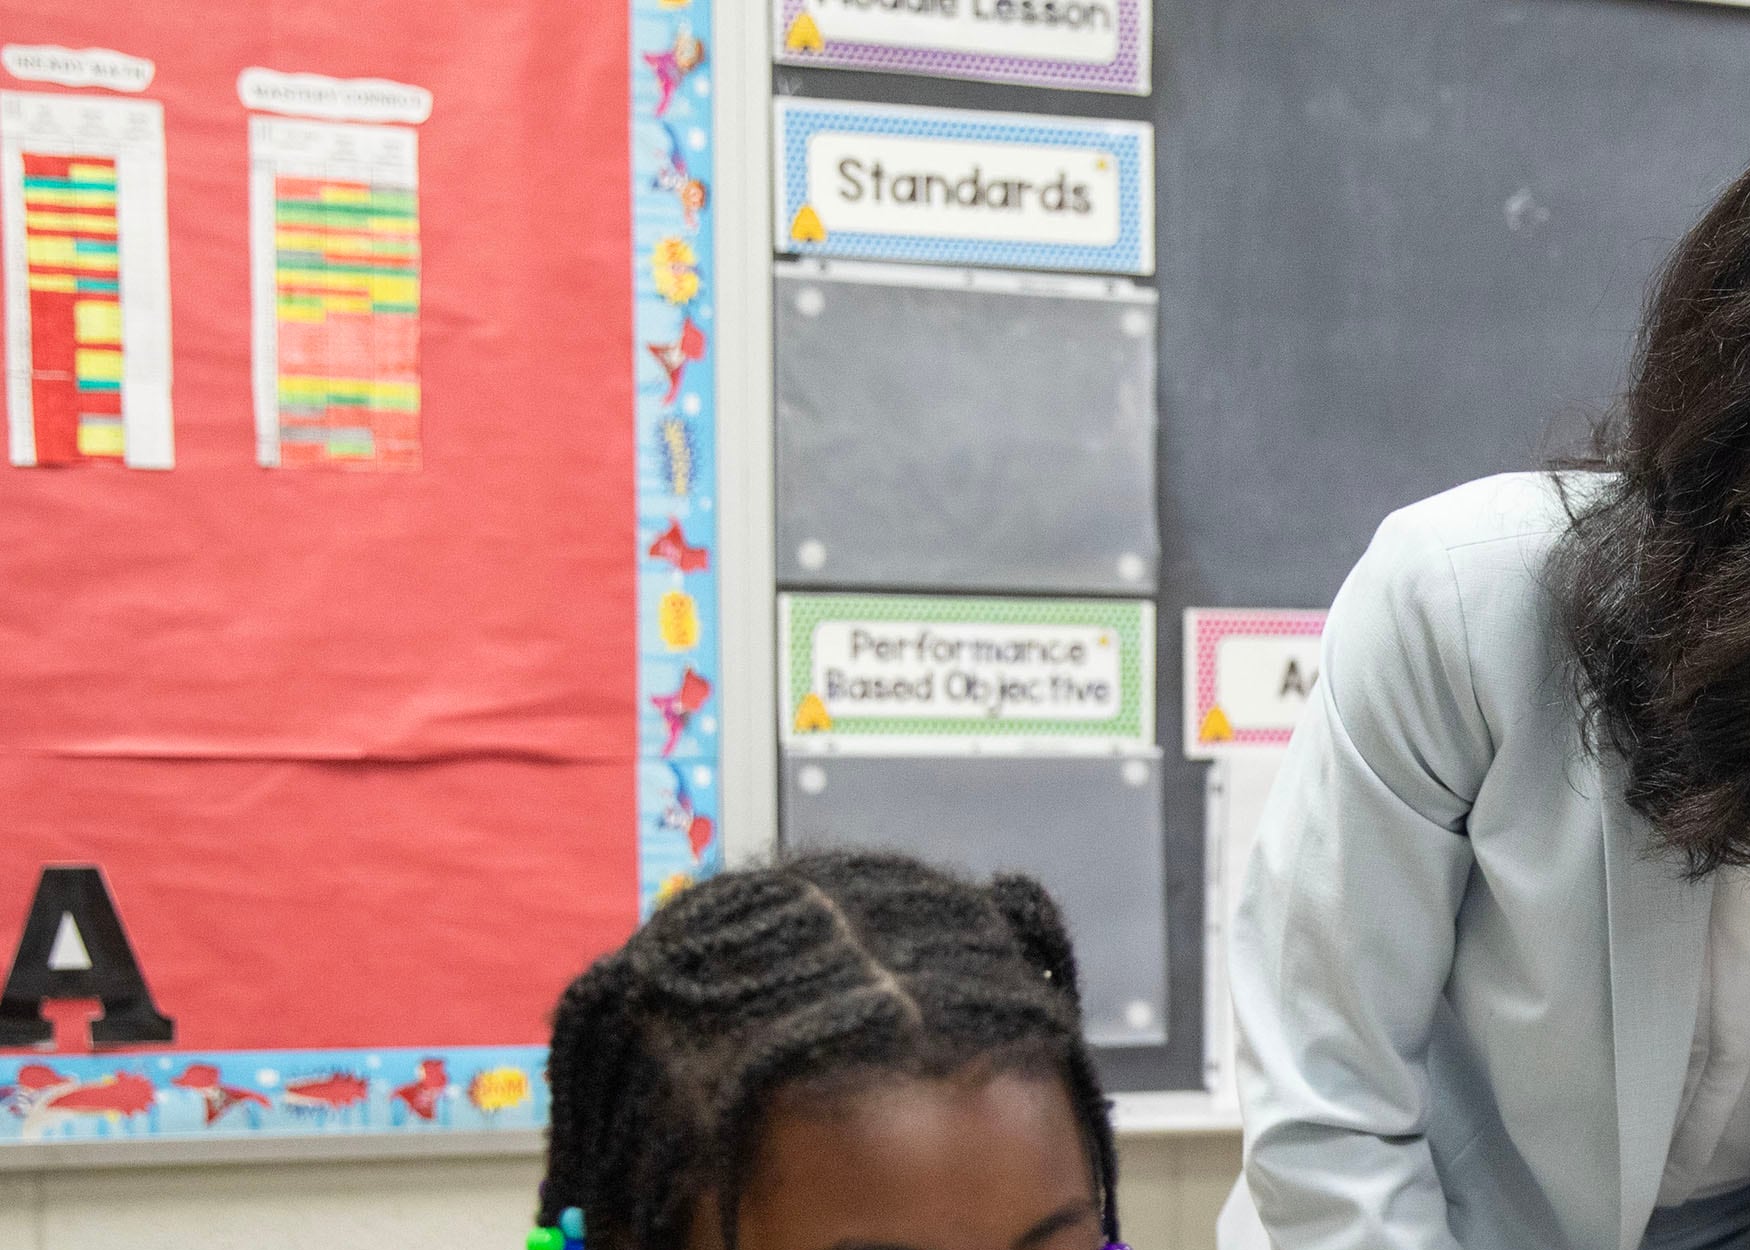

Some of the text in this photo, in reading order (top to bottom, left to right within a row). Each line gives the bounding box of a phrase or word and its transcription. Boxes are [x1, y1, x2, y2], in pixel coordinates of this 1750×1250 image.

[838, 156, 1093, 215] Standards
[850, 628, 1086, 662] Performance
[825, 666, 1110, 719] Based Objective
